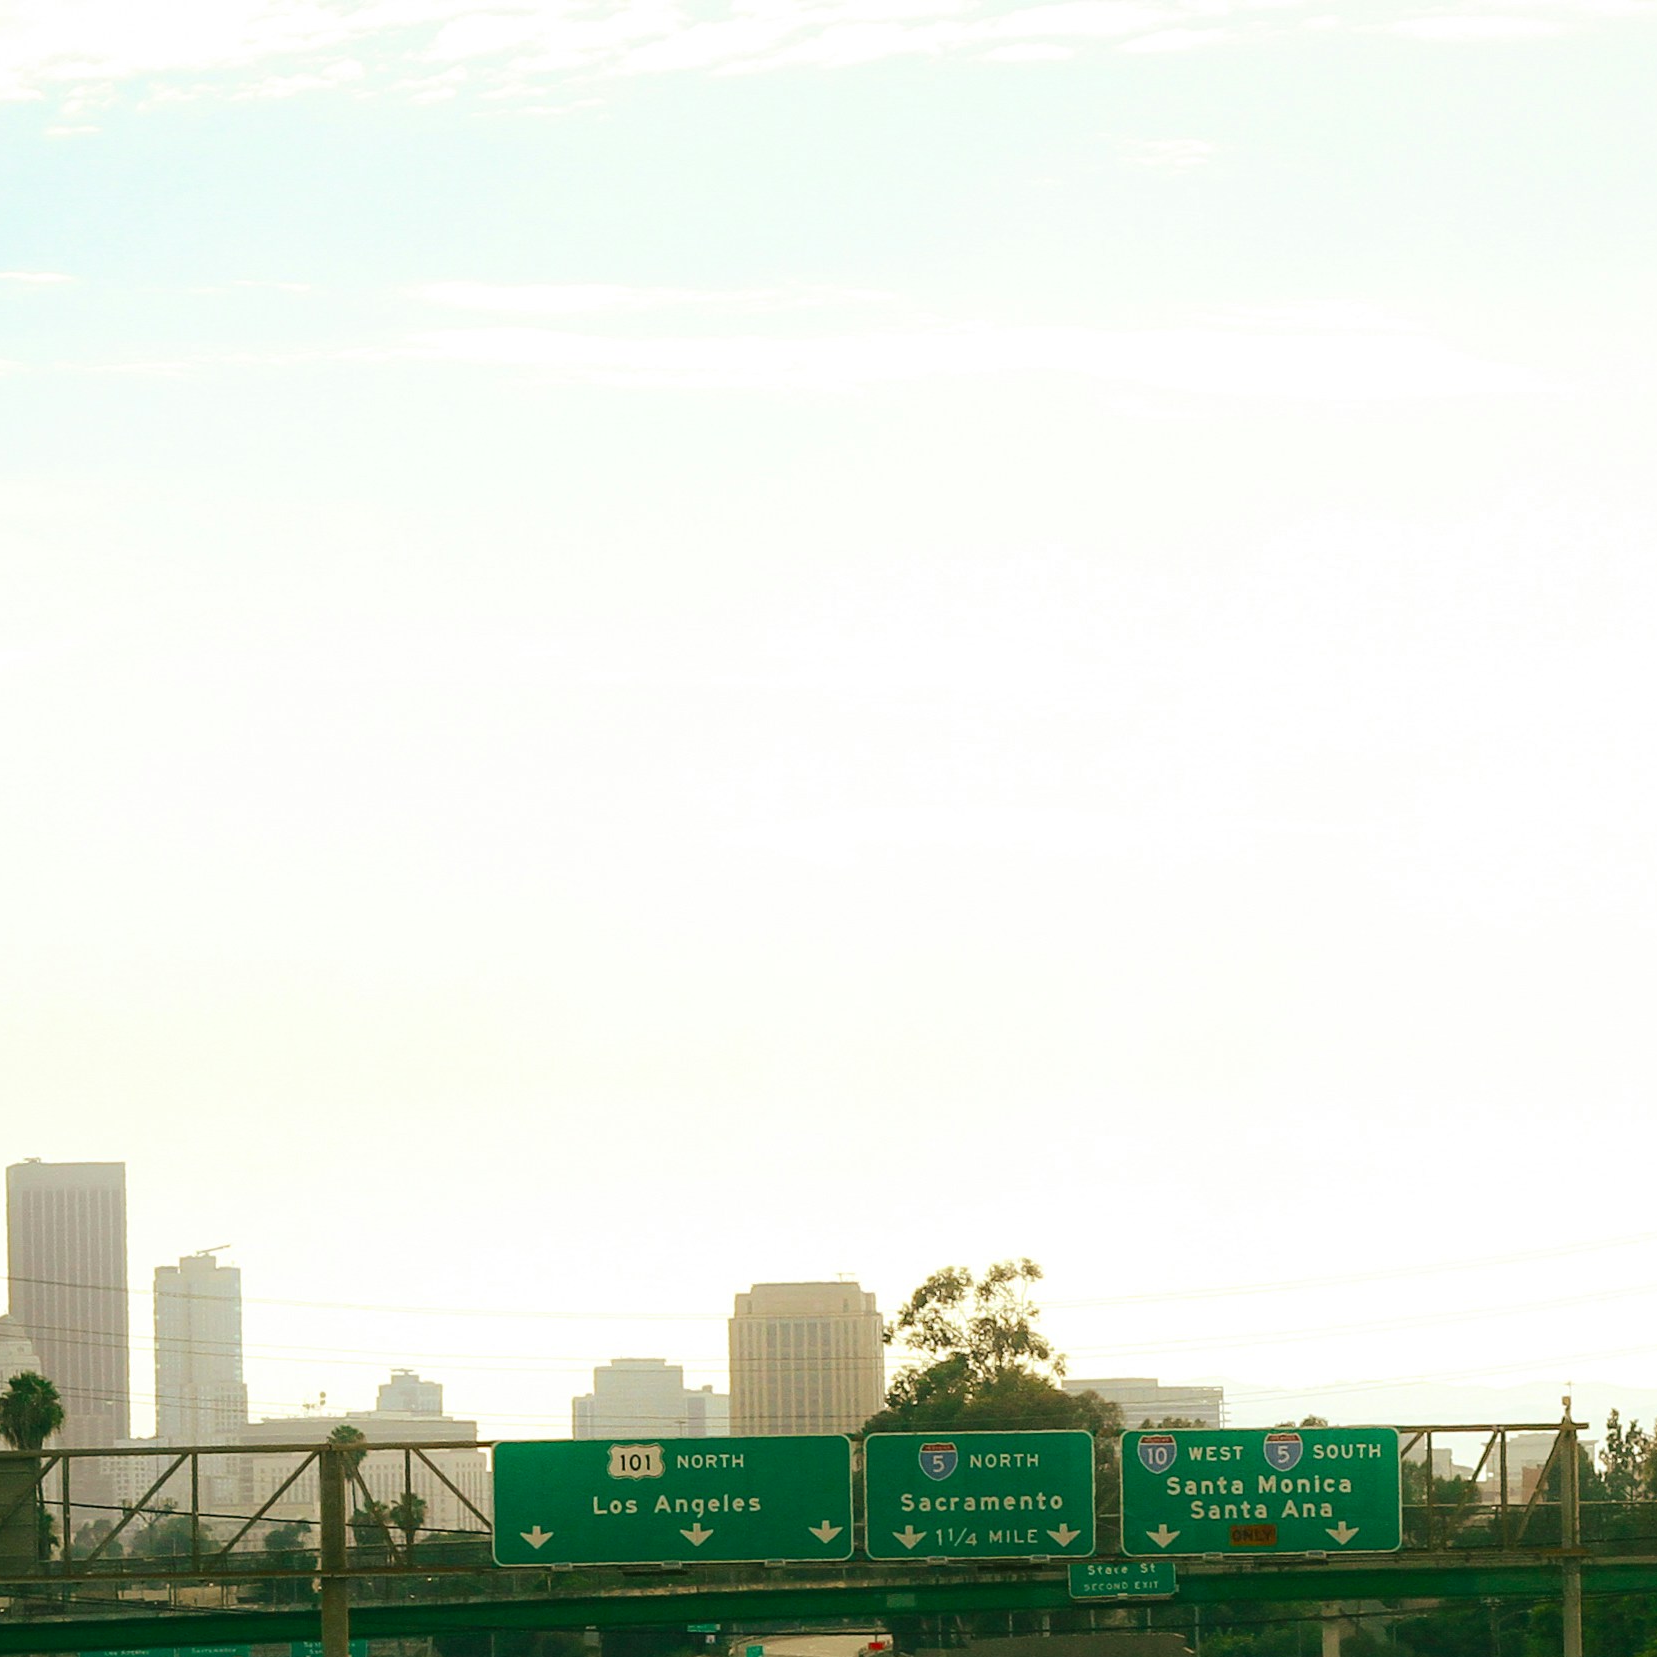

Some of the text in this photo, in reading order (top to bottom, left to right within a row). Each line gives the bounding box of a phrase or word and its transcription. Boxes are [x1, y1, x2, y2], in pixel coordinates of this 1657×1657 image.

[620, 1454, 744, 1471] 101 NORTH
[932, 1453, 1039, 1473] 5 NORTH
[1147, 1444, 1381, 1465] 10 WEST 5 SOUTH
[1167, 1475, 1352, 1495] Santa Monica
[593, 1494, 762, 1518] Los Angeles
[900, 1492, 1063, 1512] Sacramento
[1191, 1500, 1333, 1519] Santa Ana
[989, 1529, 1038, 1544] MILE
[1232, 1528, 1273, 1542] ONLY
[1087, 1563, 1155, 1575] State St
[1084, 1581, 1158, 1591] SECOND EXIT
